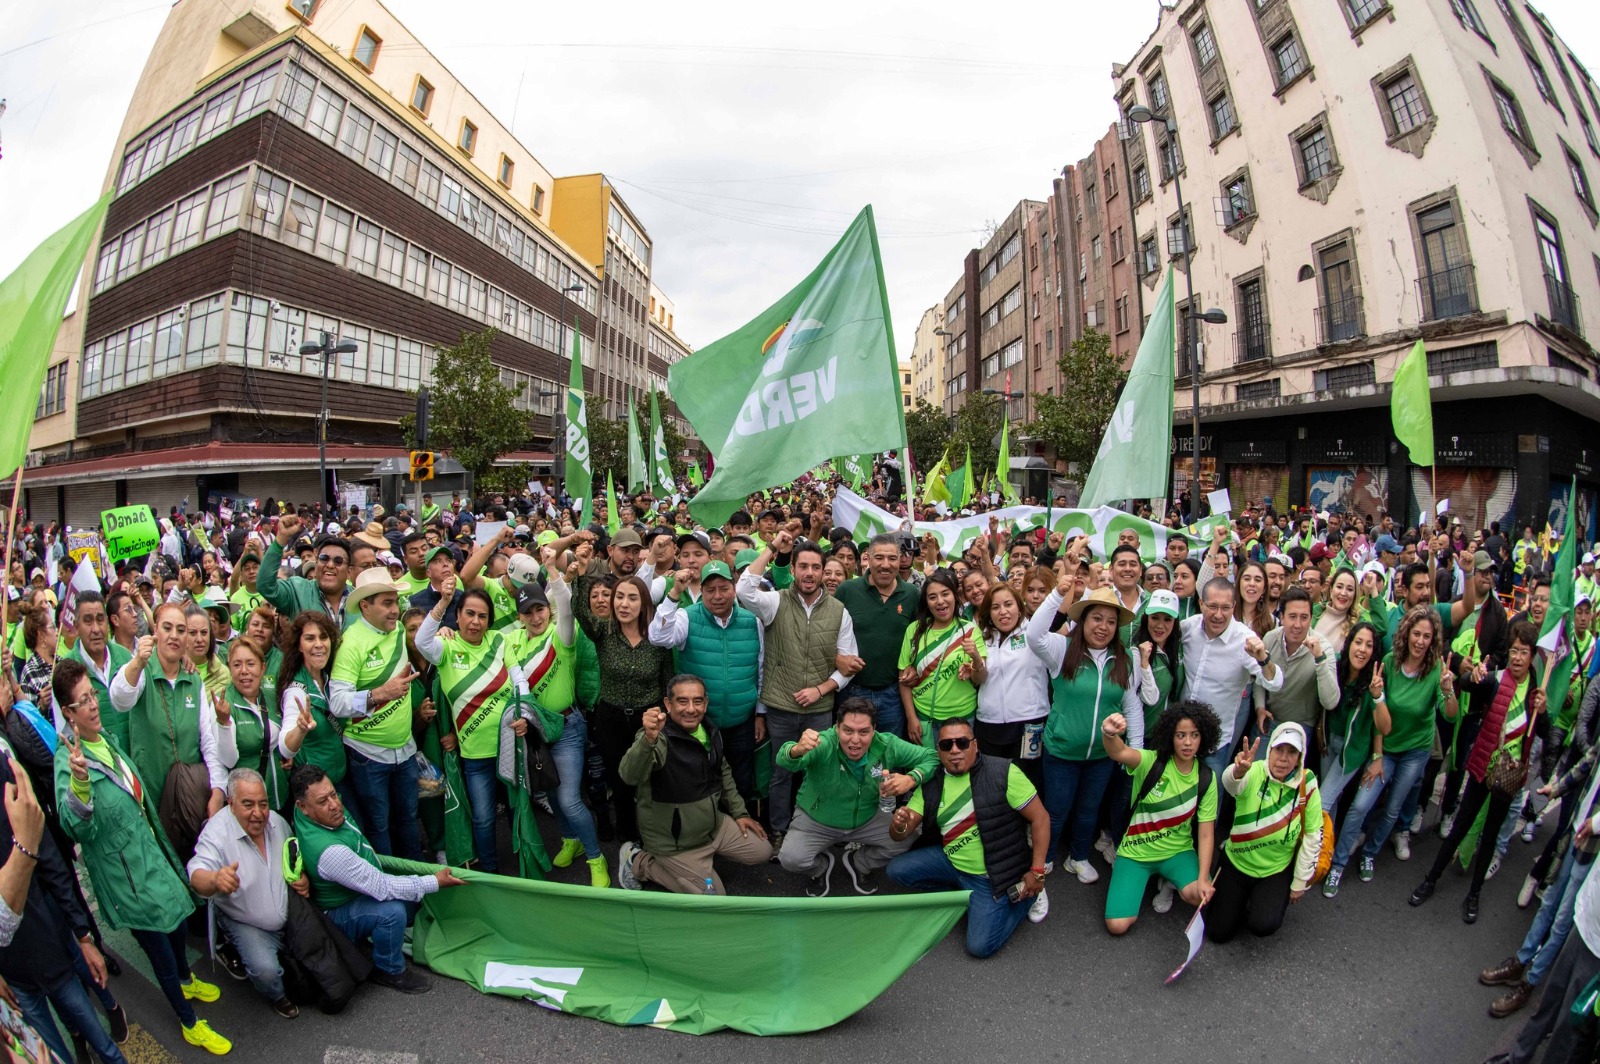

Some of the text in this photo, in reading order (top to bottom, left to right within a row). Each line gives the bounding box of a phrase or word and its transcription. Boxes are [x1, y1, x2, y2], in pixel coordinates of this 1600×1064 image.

[566, 417, 591, 476] RD
[1178, 436, 1213, 452] TREDY
[109, 536, 156, 559] Joquicingo
[367, 658, 385, 668] VERDE
[363, 695, 405, 731] PRESIDENT
[464, 696, 500, 737] PRESIDENTA
